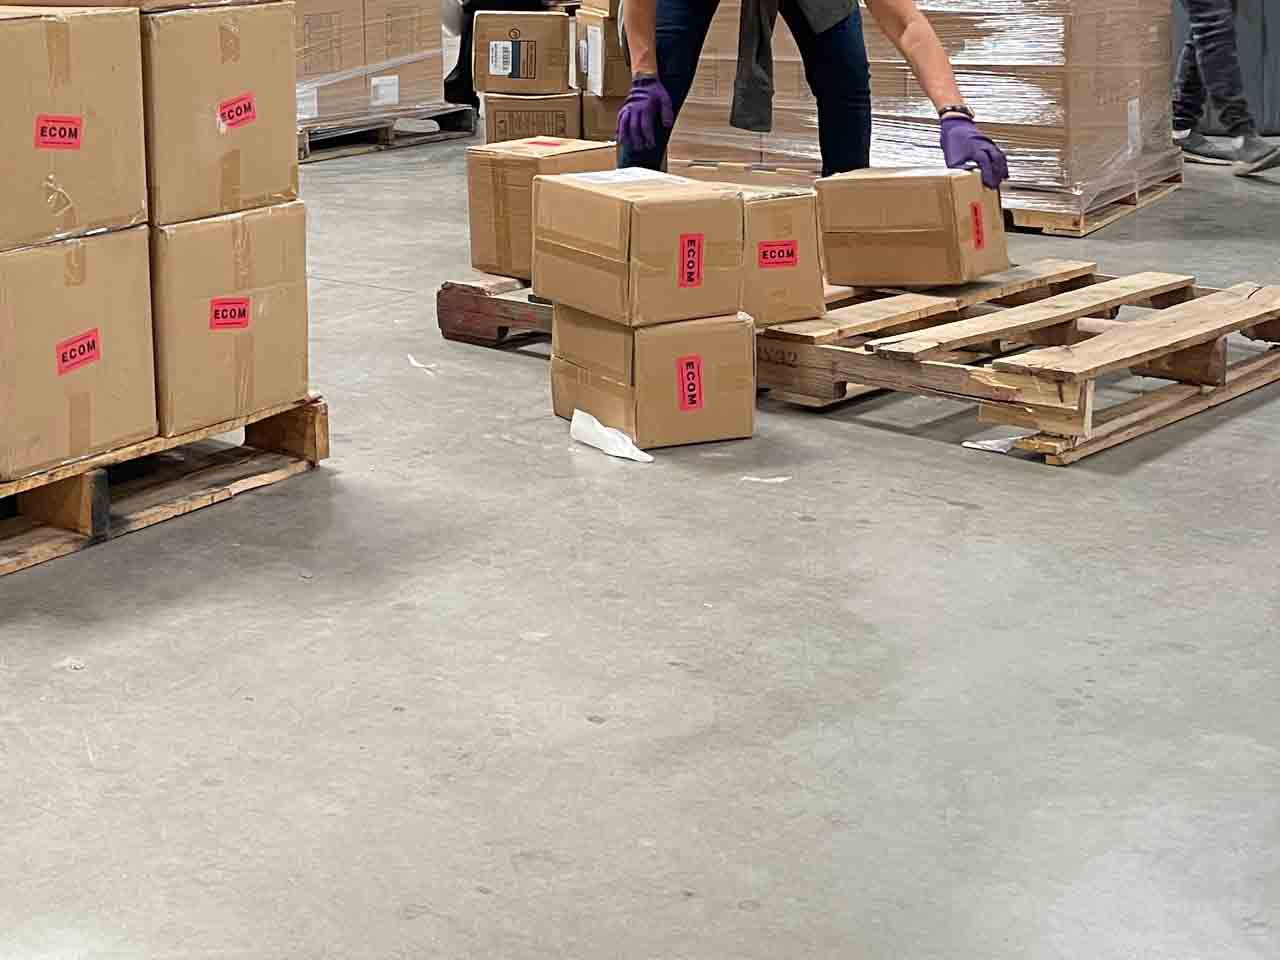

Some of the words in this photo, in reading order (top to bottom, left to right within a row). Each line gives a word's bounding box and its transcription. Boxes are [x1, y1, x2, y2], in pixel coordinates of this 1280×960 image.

[220, 101, 252, 122] ECOM
[40, 126, 78, 139] ECOM
[686, 239, 696, 282] ECOM
[762, 248, 794, 259] ECOM
[214, 307, 246, 320] ECOM
[61, 339, 96, 364] ECOM
[686, 361, 697, 405] ECOM
